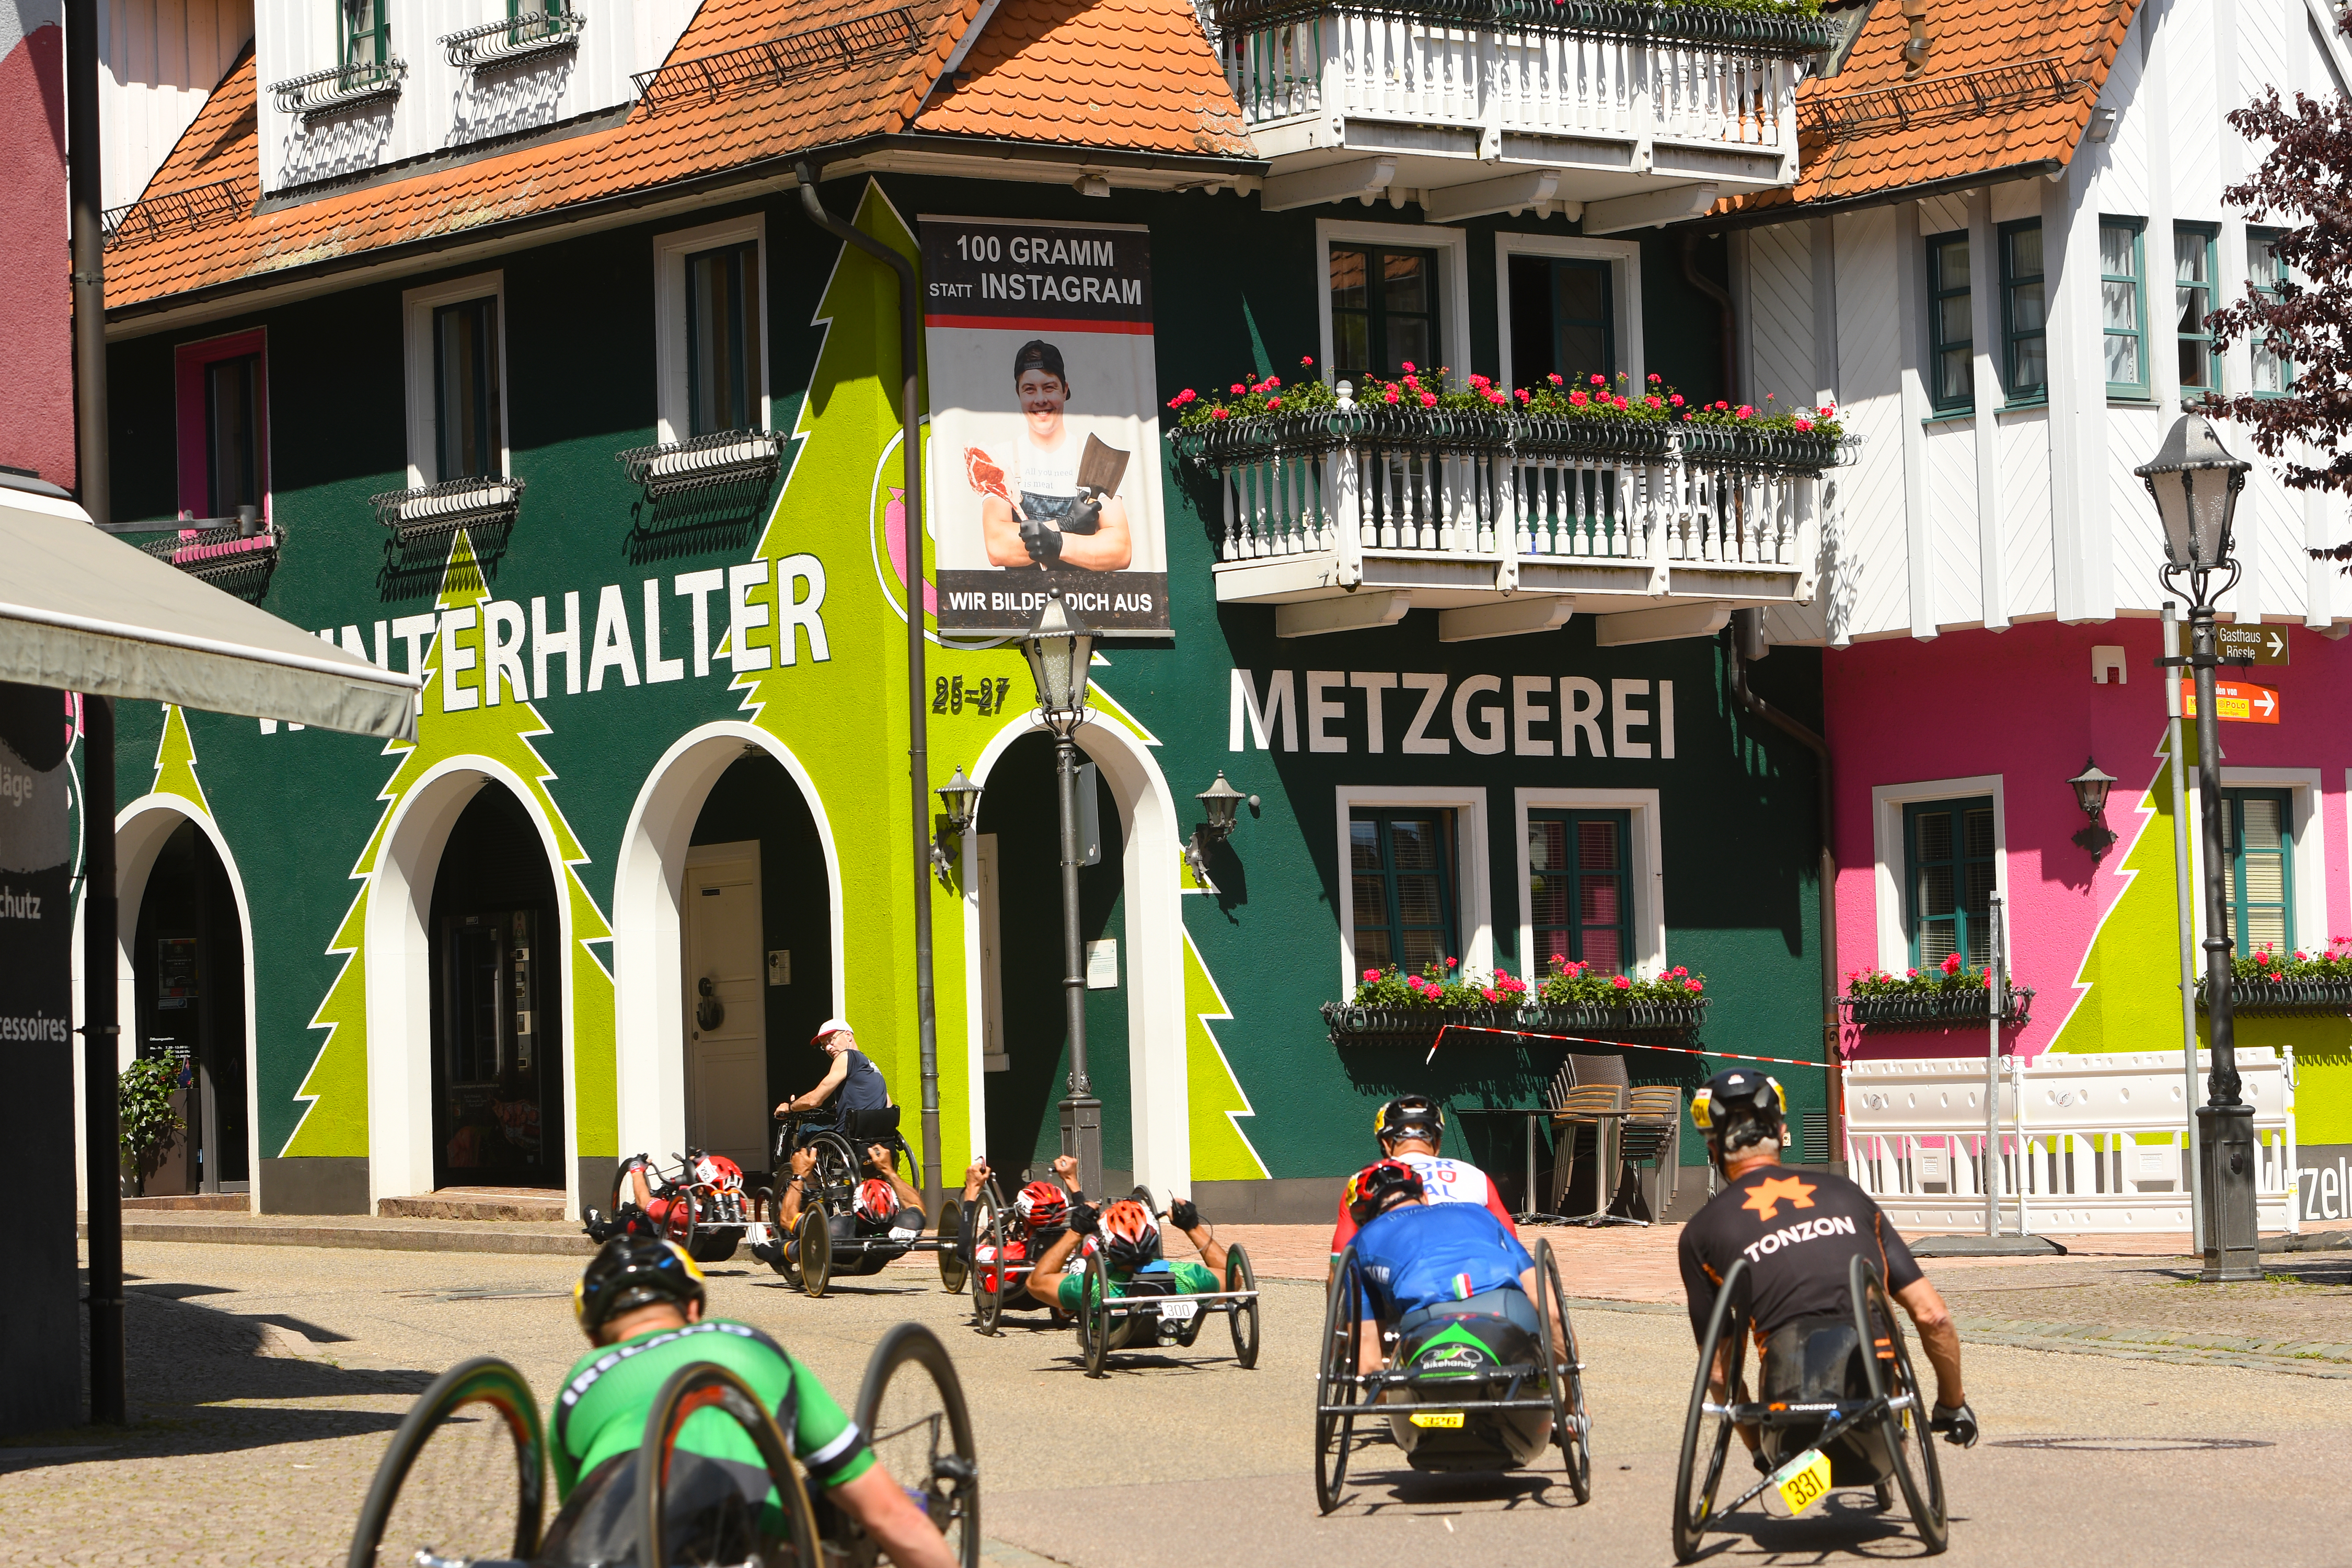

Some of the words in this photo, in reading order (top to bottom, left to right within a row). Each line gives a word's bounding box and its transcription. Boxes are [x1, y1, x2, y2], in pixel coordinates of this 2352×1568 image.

[956, 235, 1001, 261] 100
[1009, 237, 1114, 267] GRAMM
[929, 283, 973, 298] STATT
[981, 273, 1142, 305] INSTAGRAM
[1033, 481, 1053, 489] meat
[949, 592, 987, 610] WIR
[1065, 593, 1110, 611] DICH
[1114, 593, 1153, 613] AUS
[2220, 628, 2261, 643] Gasthaus
[2226, 645, 2256, 660] Rössle
[932, 674, 1010, 708] 25-27
[2227, 687, 2238, 696] von
[1228, 668, 1675, 759] METZGEREI
[2226, 701, 2246, 709] POLO
[1411, 1160, 1455, 1170] OR
[1427, 1183, 1458, 1200] AL
[1744, 1216, 1857, 1263] TONZON
[1167, 1304, 1190, 1316] 300
[561, 1322, 753, 1406] IRELAND
[1423, 1359, 1477, 1370] Bikehandy
[1788, 1466, 1824, 1505] 331
